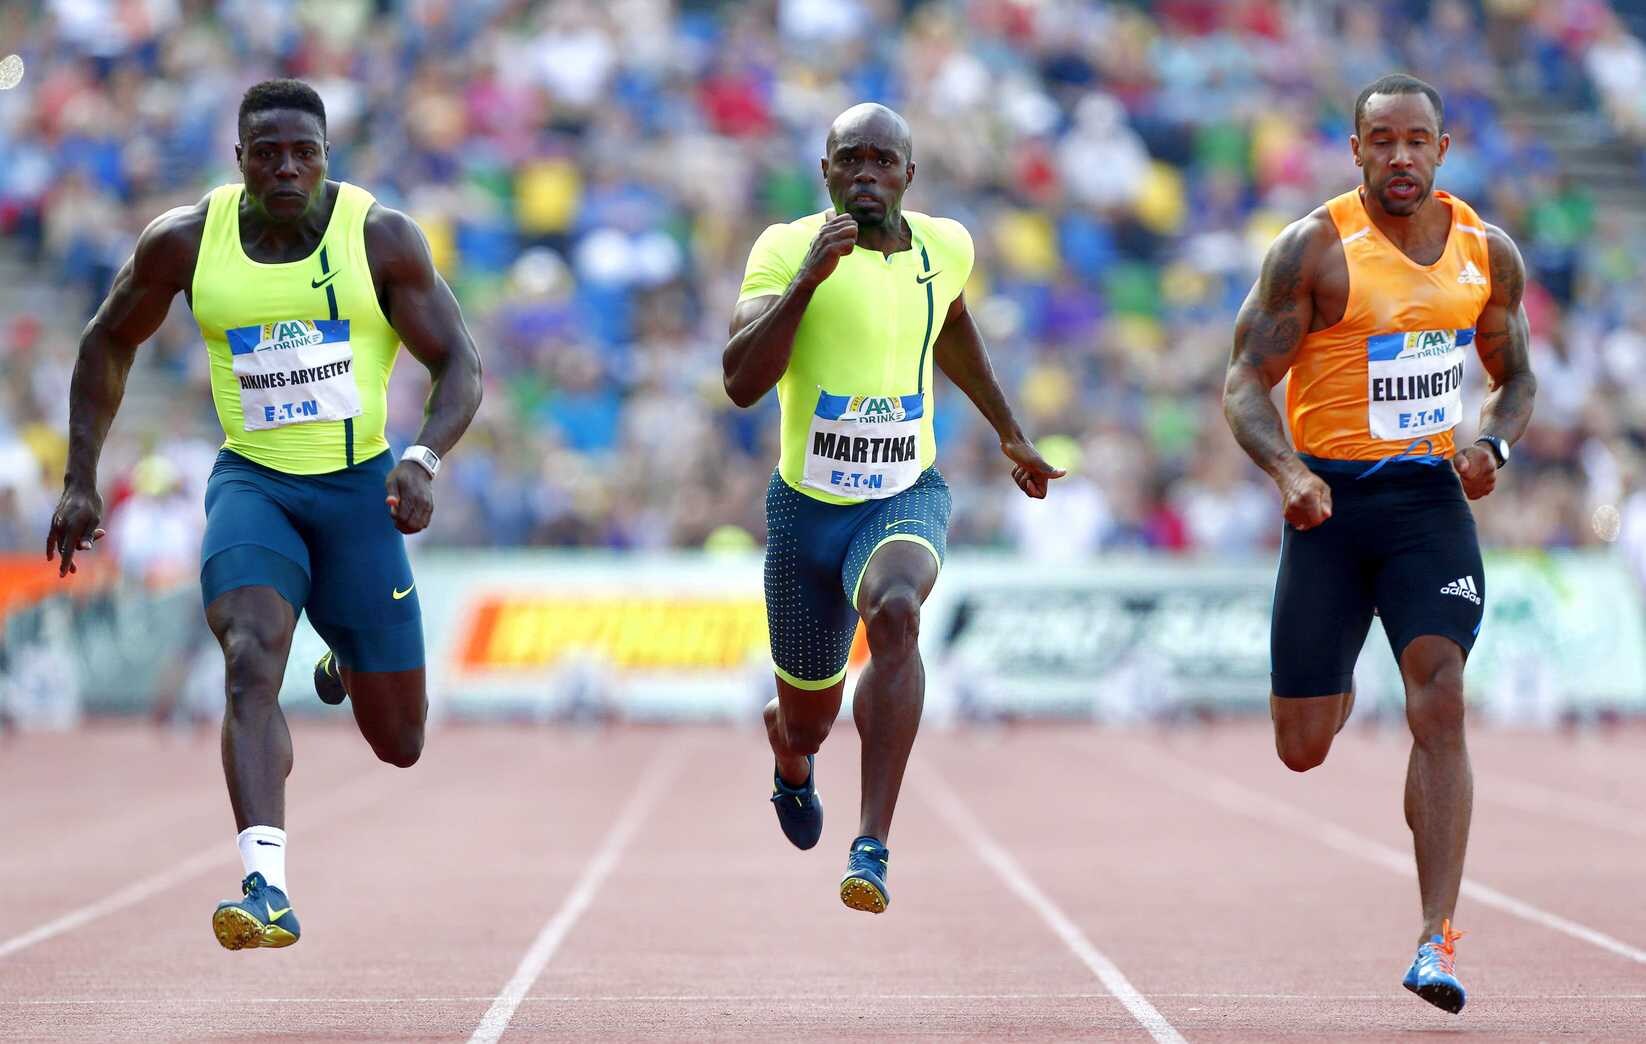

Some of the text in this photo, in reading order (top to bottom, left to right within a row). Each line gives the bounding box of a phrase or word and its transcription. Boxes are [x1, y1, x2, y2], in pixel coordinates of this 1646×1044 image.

[279, 321, 305, 341] AA
[1423, 331, 1446, 350] AA
[274, 335, 312, 351] DRINK
[1417, 344, 1452, 359] DRINK
[240, 359, 352, 390] AIKINES-ARYEETEY
[865, 398, 892, 416] AA
[859, 413, 895, 424] DRINK
[813, 431, 916, 463] MARTINA
[1440, 586, 1481, 605] adidas
